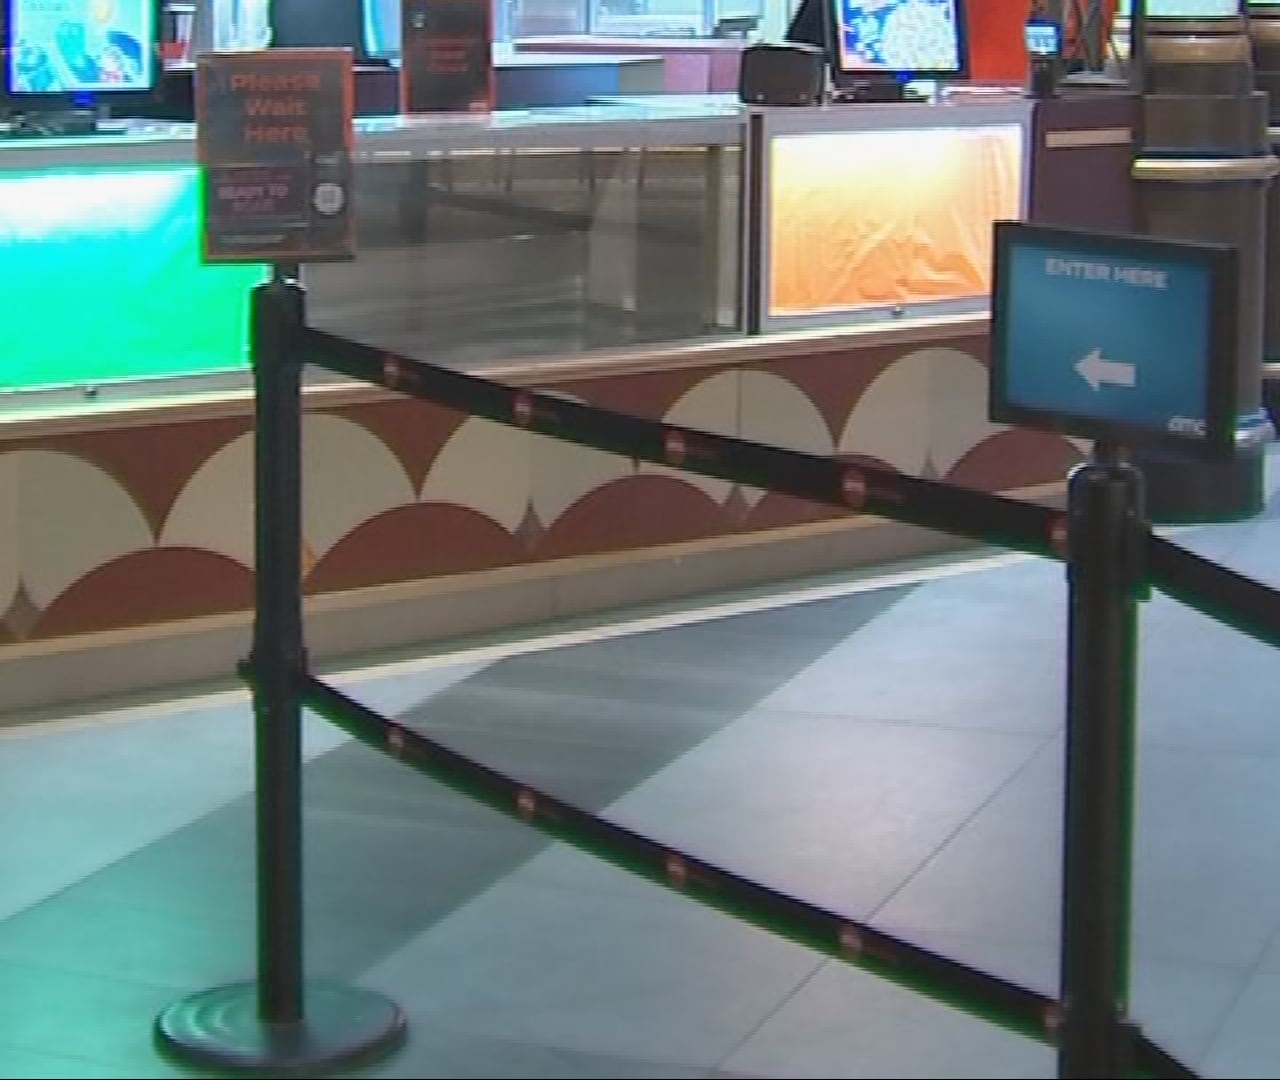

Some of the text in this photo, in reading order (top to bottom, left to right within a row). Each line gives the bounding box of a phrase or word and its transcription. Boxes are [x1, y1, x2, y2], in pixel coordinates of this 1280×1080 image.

[245, 97, 306, 117] Wait
[1045, 257, 1169, 291] ENTER HERE
